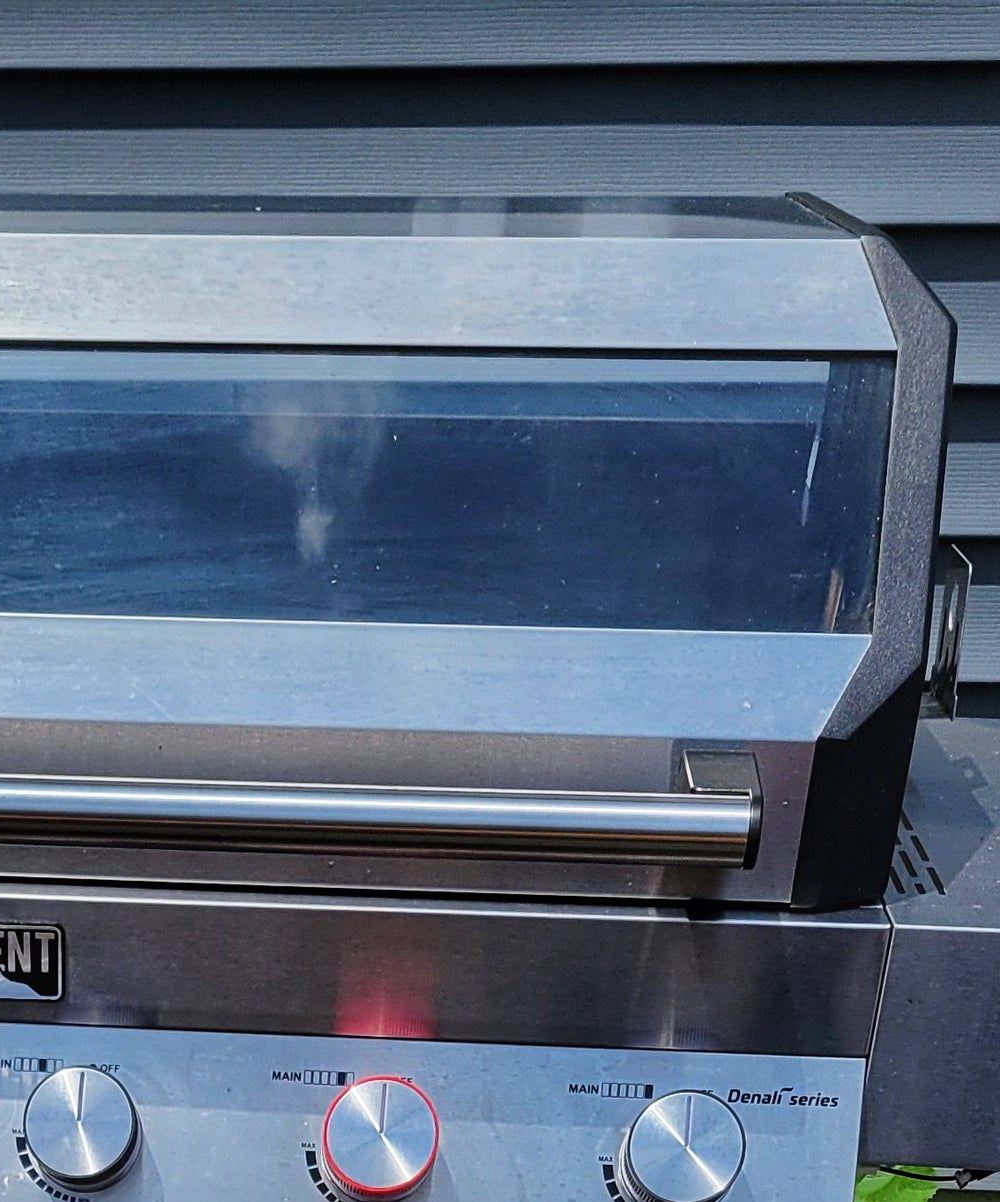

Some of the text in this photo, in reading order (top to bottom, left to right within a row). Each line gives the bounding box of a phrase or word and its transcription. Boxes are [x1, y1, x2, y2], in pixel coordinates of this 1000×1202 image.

[100, 1064, 120, 1073] OFF
[272, 1071, 302, 1082] MAIN
[568, 1084, 599, 1095] MAIN
[727, 1088, 839, 1107] Denali series
